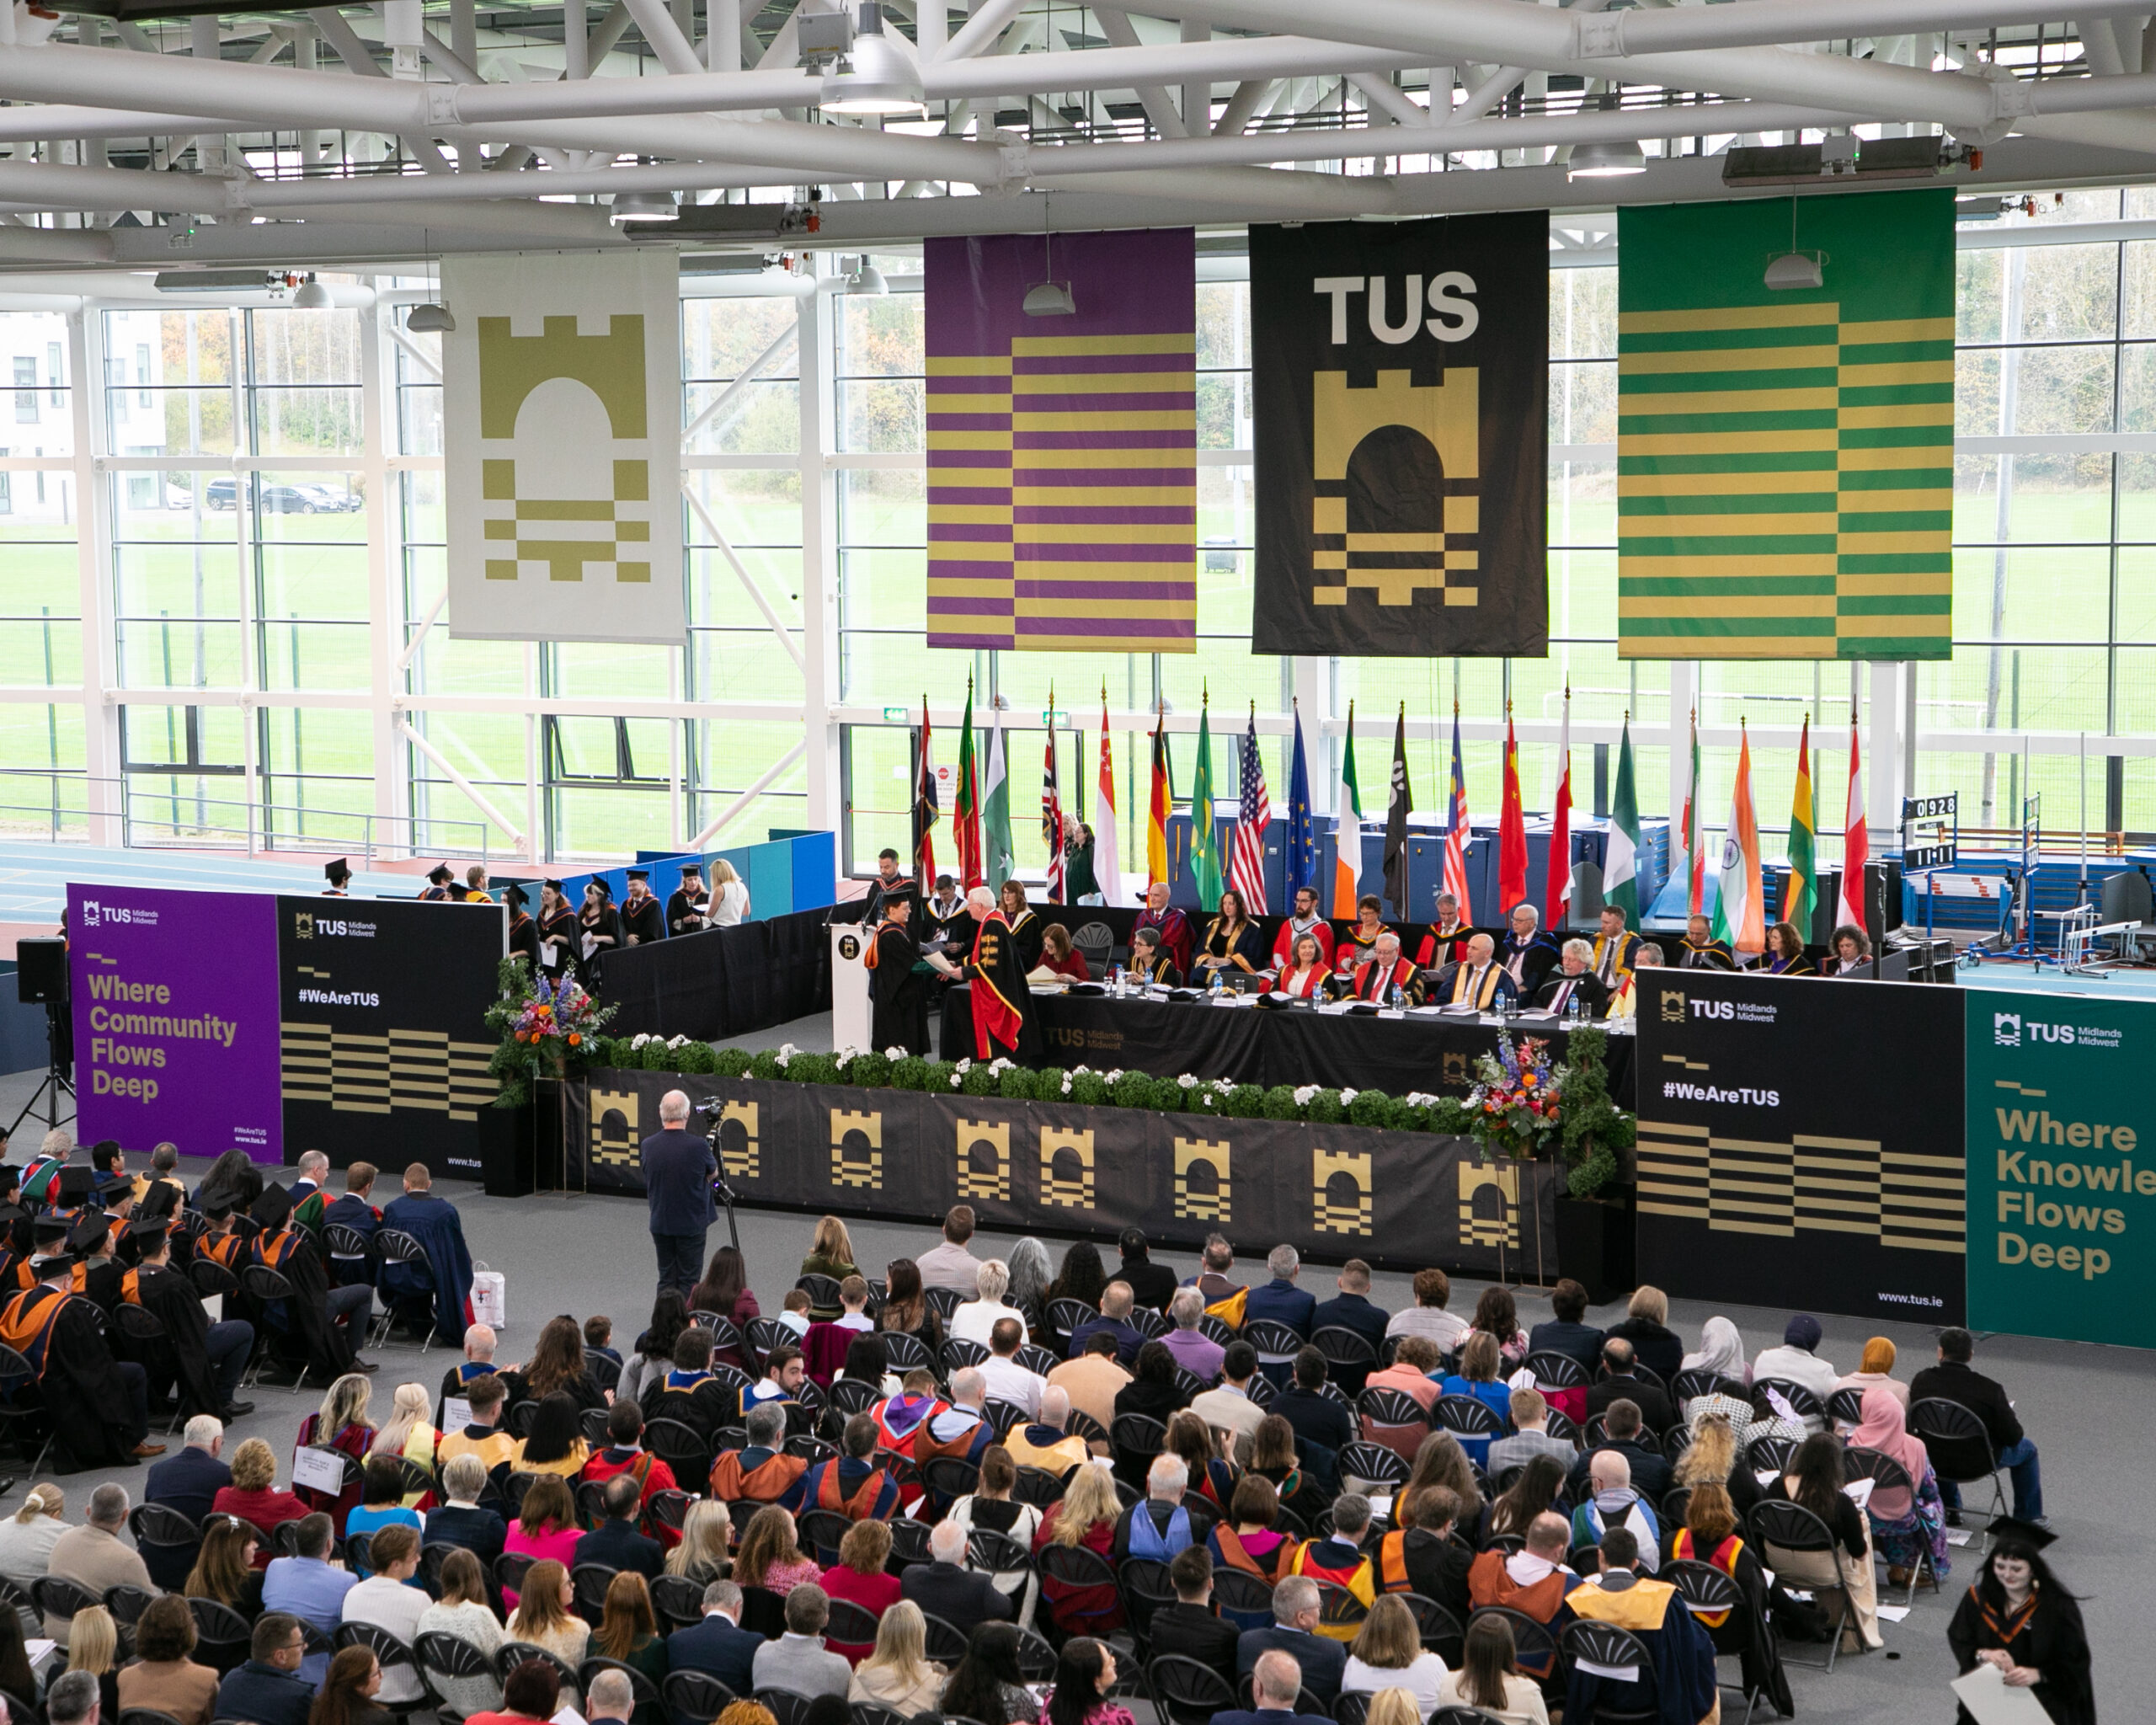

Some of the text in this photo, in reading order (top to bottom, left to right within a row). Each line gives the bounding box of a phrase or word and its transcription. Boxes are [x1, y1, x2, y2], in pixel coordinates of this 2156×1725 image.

[1314, 270, 1479, 344] TUS
[102, 907, 131, 923] TUS
[133, 916, 157, 925] Midwest
[316, 920, 347, 936] TUS
[348, 921, 376, 930] Midlands
[349, 929, 375, 937] Midwest
[88, 974, 171, 1005] Where
[298, 989, 379, 1007] #WeAreTUS
[1689, 999, 1735, 1020] TUS
[1737, 1003, 1777, 1013] Midlands
[1737, 1012, 1774, 1023] Midwest
[89, 1006, 237, 1048] Community
[2025, 1022, 2075, 1044] TUS
[2078, 1026, 2122, 1038] Midlands
[1086, 1030, 1124, 1041] Midlands
[2078, 1036, 2119, 1047] Midwest
[1086, 1039, 1121, 1050] Midwest
[92, 1038, 167, 1068] Flows
[93, 1069, 159, 1104] Deep
[1663, 1081, 1780, 1107] #WeAreTUS
[234, 1126, 267, 1136] #WeAreTUS
[1995, 1108, 2137, 1152] Where
[235, 1136, 267, 1145] www.tus.ie
[1997, 1149, 2156, 1196] Knowle
[1998, 1190, 2127, 1234] Flows
[1998, 1231, 2111, 1281] Deep
[1877, 1292, 1943, 1307] www.tus.ie
